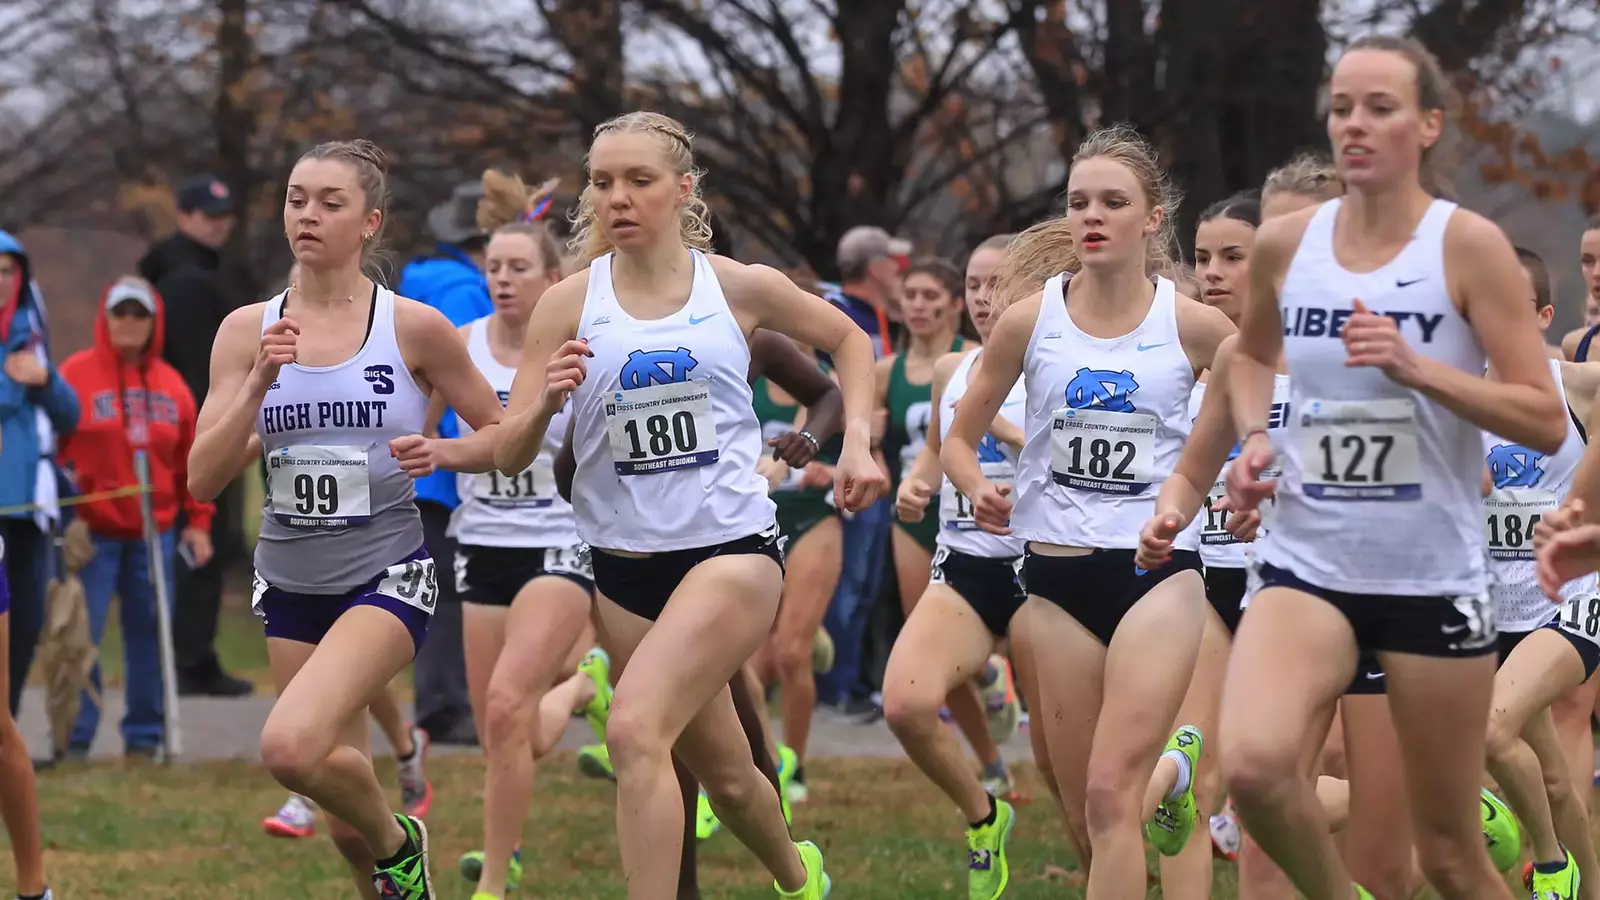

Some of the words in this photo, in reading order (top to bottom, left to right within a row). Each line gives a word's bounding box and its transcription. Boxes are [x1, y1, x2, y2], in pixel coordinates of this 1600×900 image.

[616, 404, 634, 412] CROSS
[634, 400, 660, 410] COUNTRY
[661, 392, 708, 406] CHAMPIONSHIPS
[263, 403, 312, 434] HIGH
[318, 401, 387, 428] POINT
[1064, 421, 1084, 429] CROSS
[1084, 423, 1108, 431] COUNTRY
[1109, 426, 1154, 435] CHAMPIONSHIPS
[624, 410, 698, 459] 180
[280, 458, 296, 466] CROSS
[633, 460, 667, 471] SOUTHEAST
[668, 455, 698, 467] REGIONAL
[1067, 436, 1136, 481] 182
[1319, 435, 1394, 482] 127
[294, 473, 339, 516] 99
[489, 471, 537, 498] 131
[1069, 477, 1102, 489] SOUTHEAST
[1101, 483, 1131, 492] REGIONAL
[290, 517, 320, 526] SOUTHEAST
[396, 560, 437, 609] 99
[1566, 598, 1600, 638] 18
